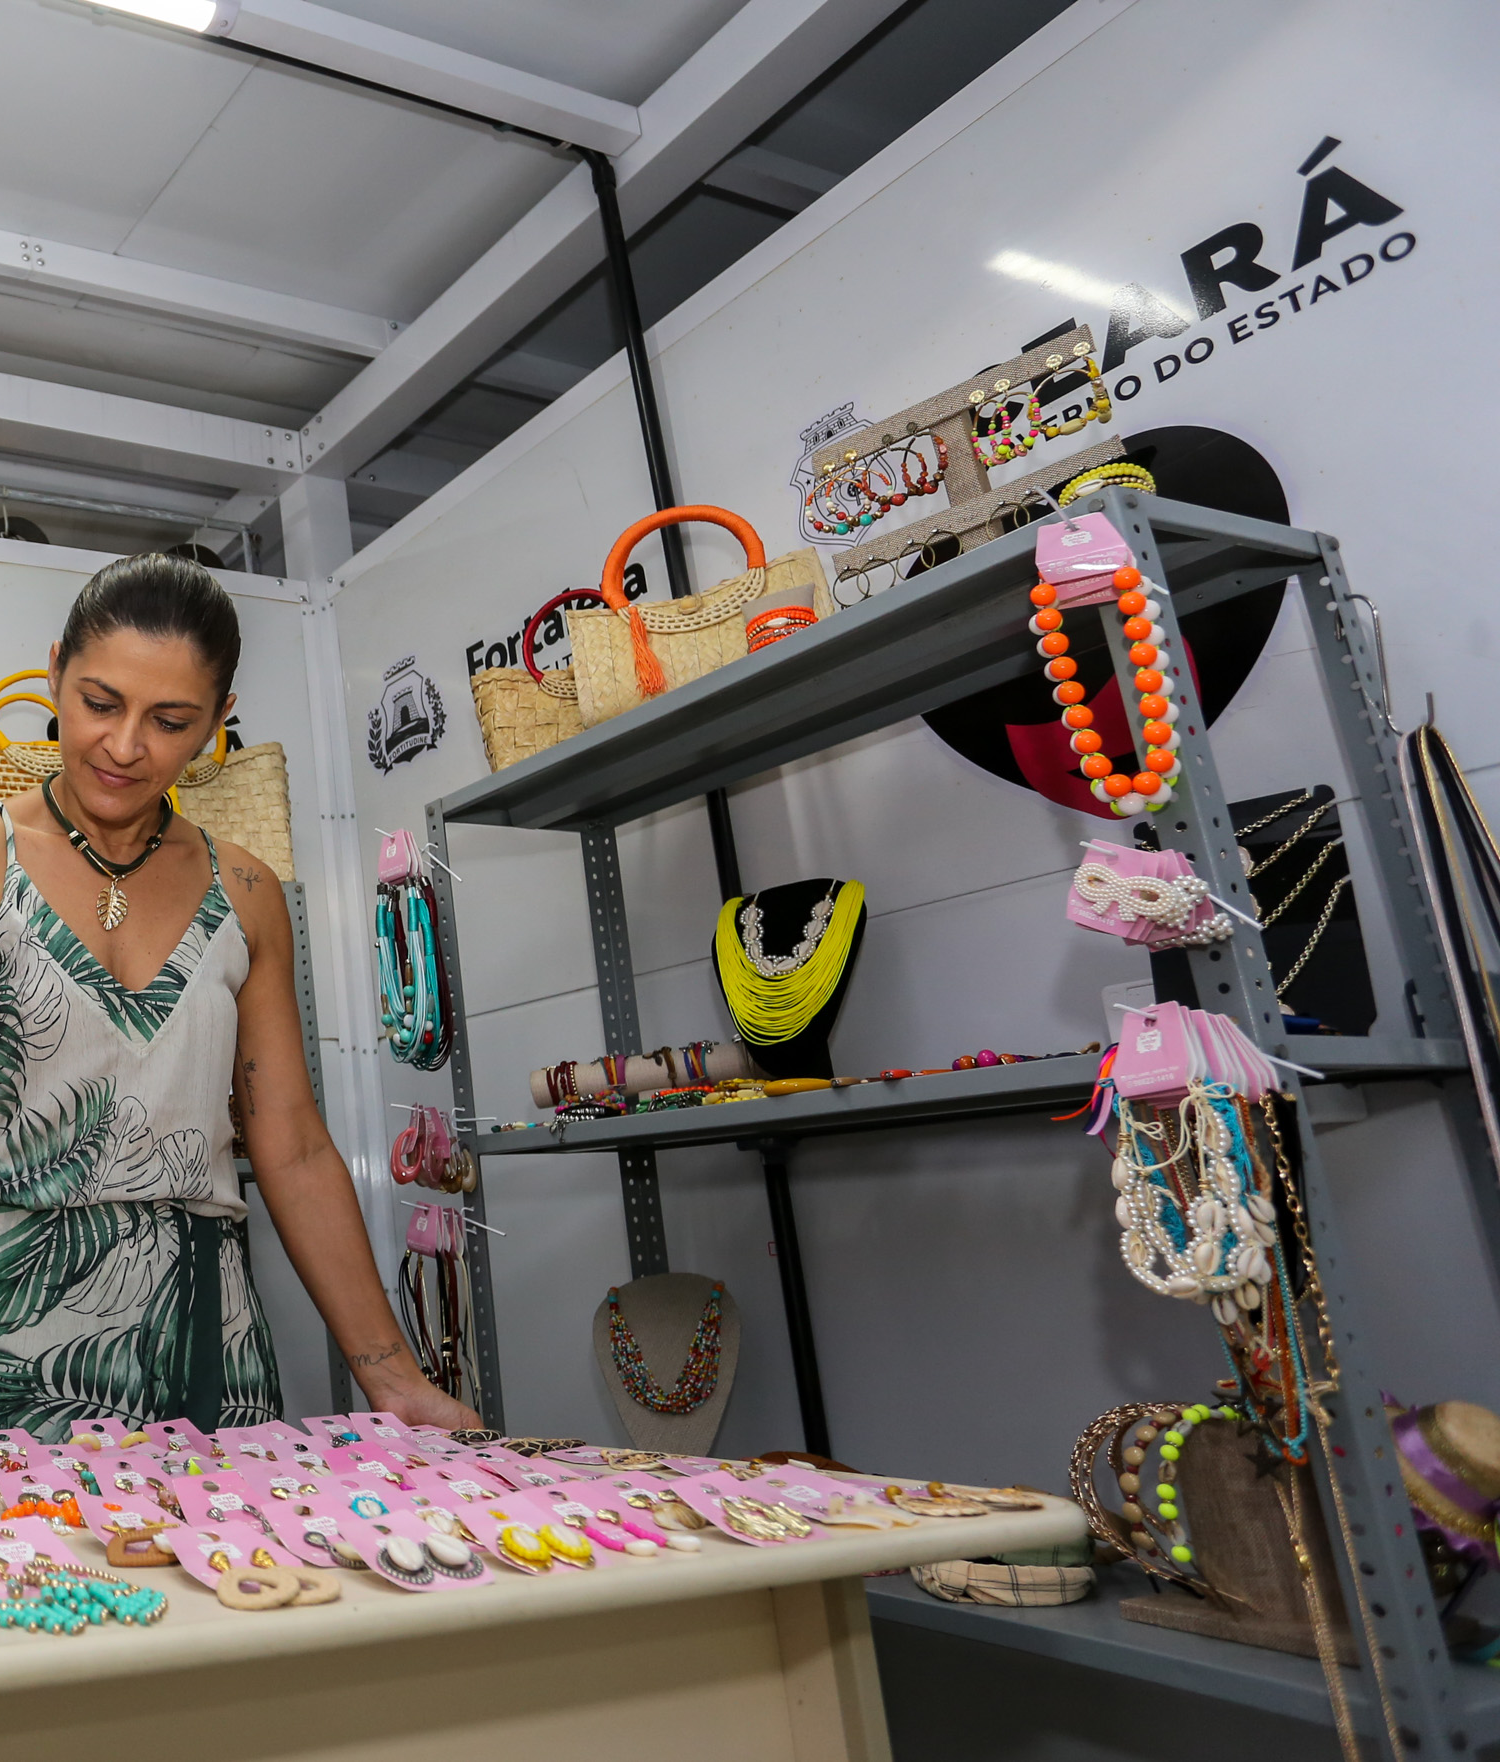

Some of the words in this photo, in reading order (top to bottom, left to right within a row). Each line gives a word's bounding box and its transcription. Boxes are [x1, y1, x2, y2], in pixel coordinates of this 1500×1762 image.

[1153, 336, 1214, 383] DO
[1227, 231, 1417, 345] ESTADO
[388, 734, 428, 762] FORTITUDINE
